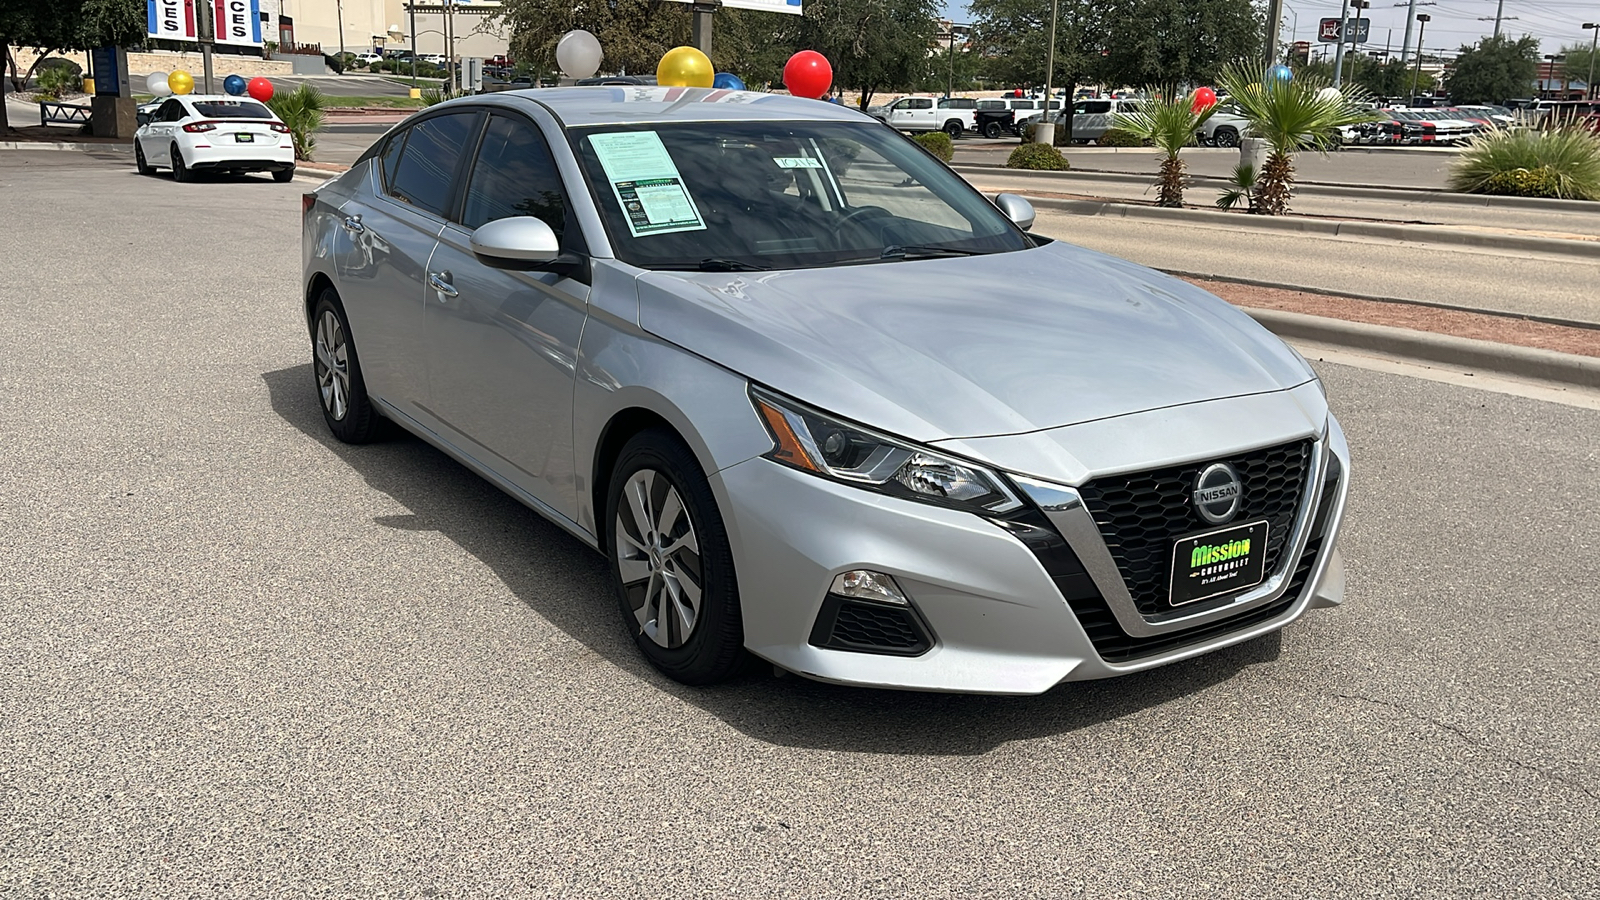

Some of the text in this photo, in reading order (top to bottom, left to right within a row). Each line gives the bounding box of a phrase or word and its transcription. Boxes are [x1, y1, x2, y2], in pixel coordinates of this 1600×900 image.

[1321, 22, 1341, 37] Jack
[1201, 486, 1238, 502] NISSAN
[1190, 538, 1250, 568] Mission
[1201, 558, 1249, 576] CHEVROLET
